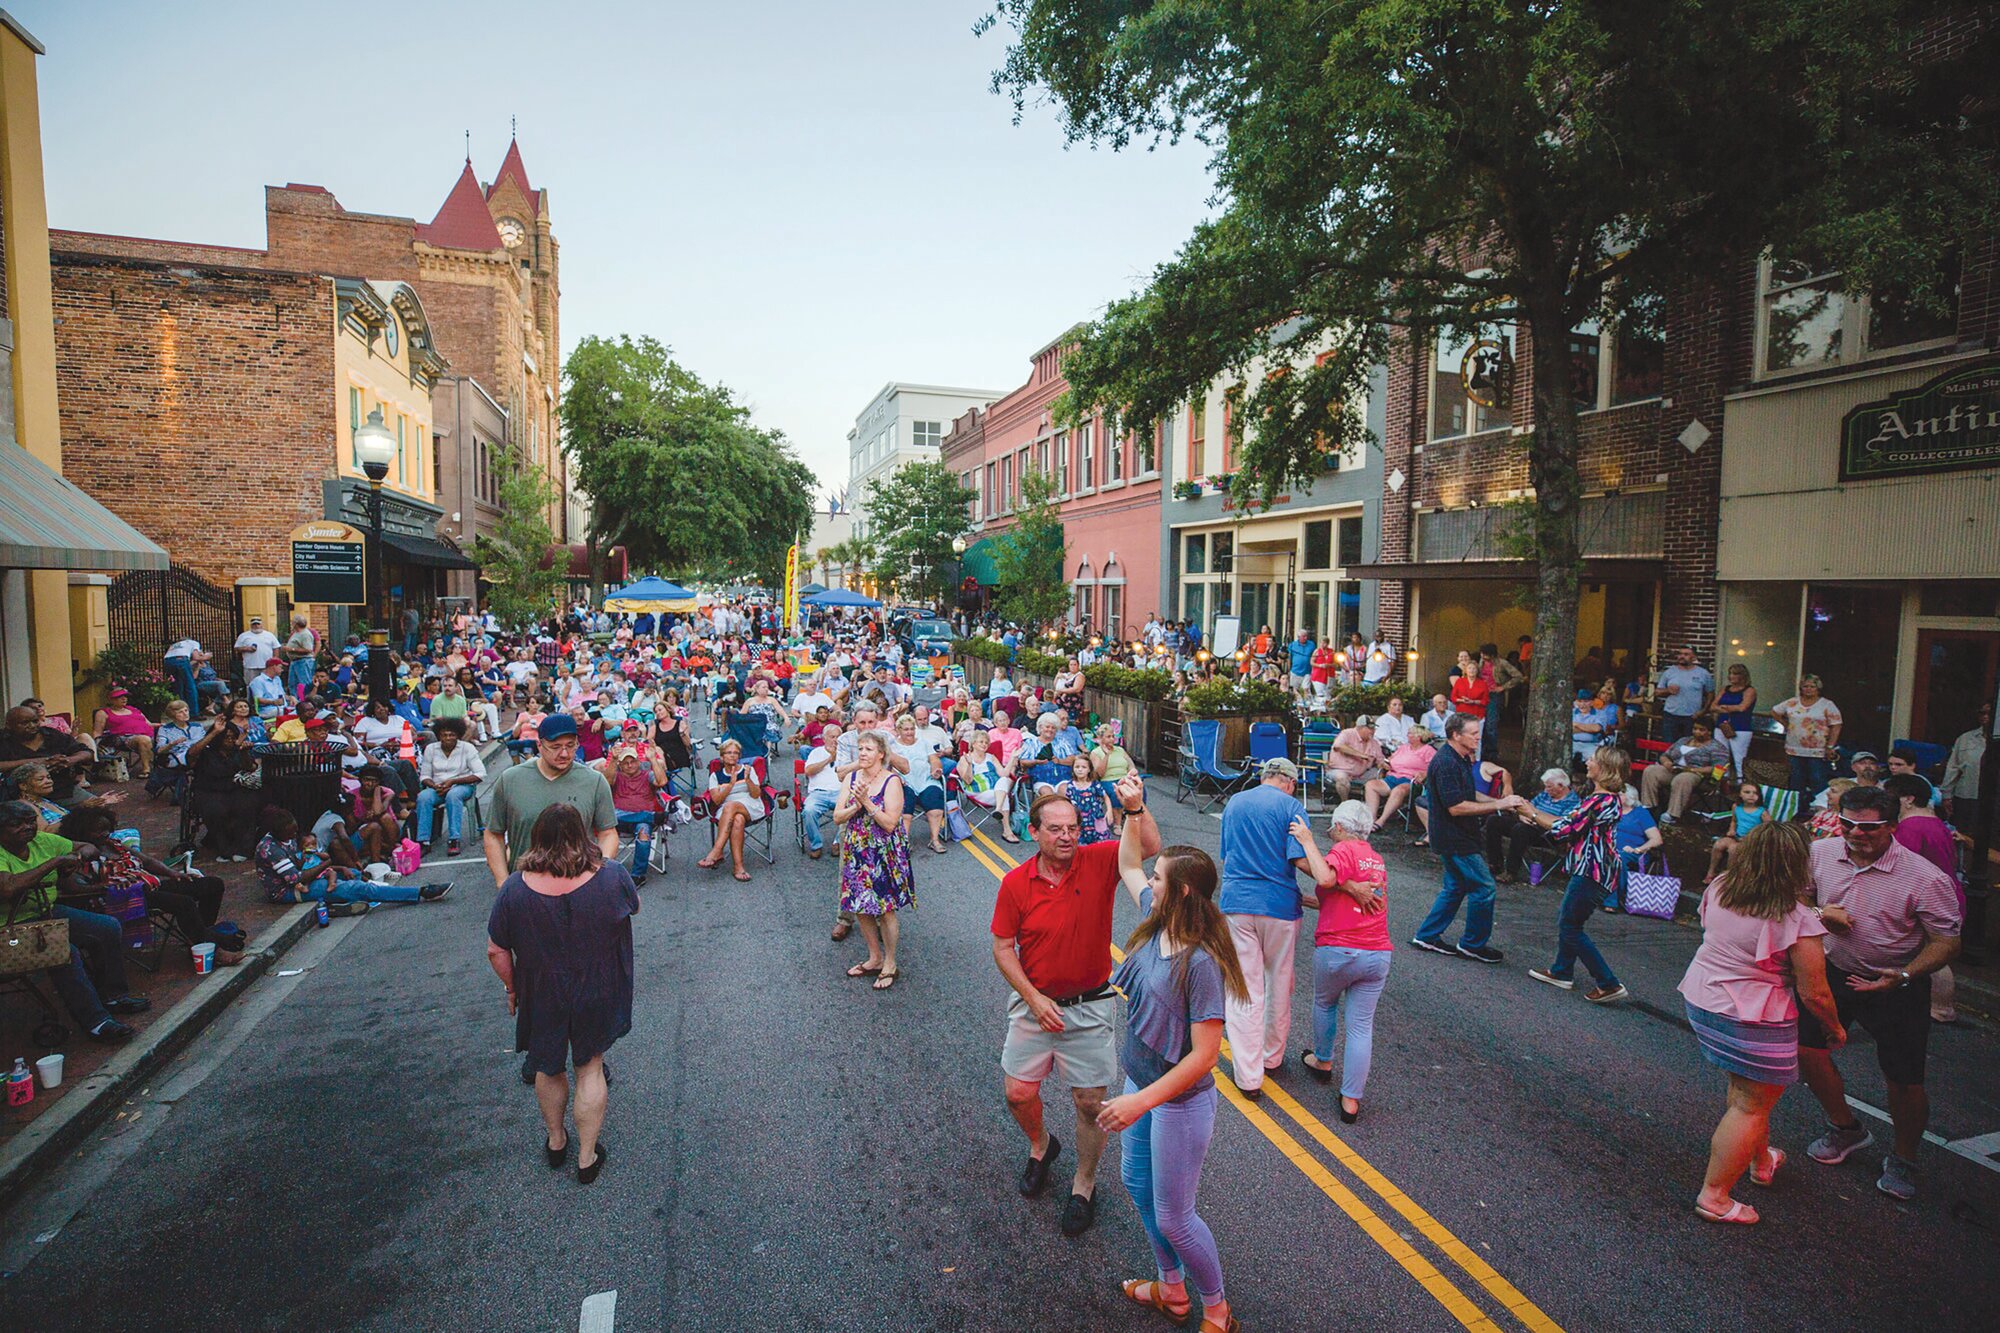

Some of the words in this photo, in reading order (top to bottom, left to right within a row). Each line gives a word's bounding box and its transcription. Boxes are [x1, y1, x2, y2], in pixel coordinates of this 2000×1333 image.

[1945, 382, 1979, 394] Main
[1888, 446, 2000, 461] COLLECTIBLES
[303, 526, 343, 539] Sumter
